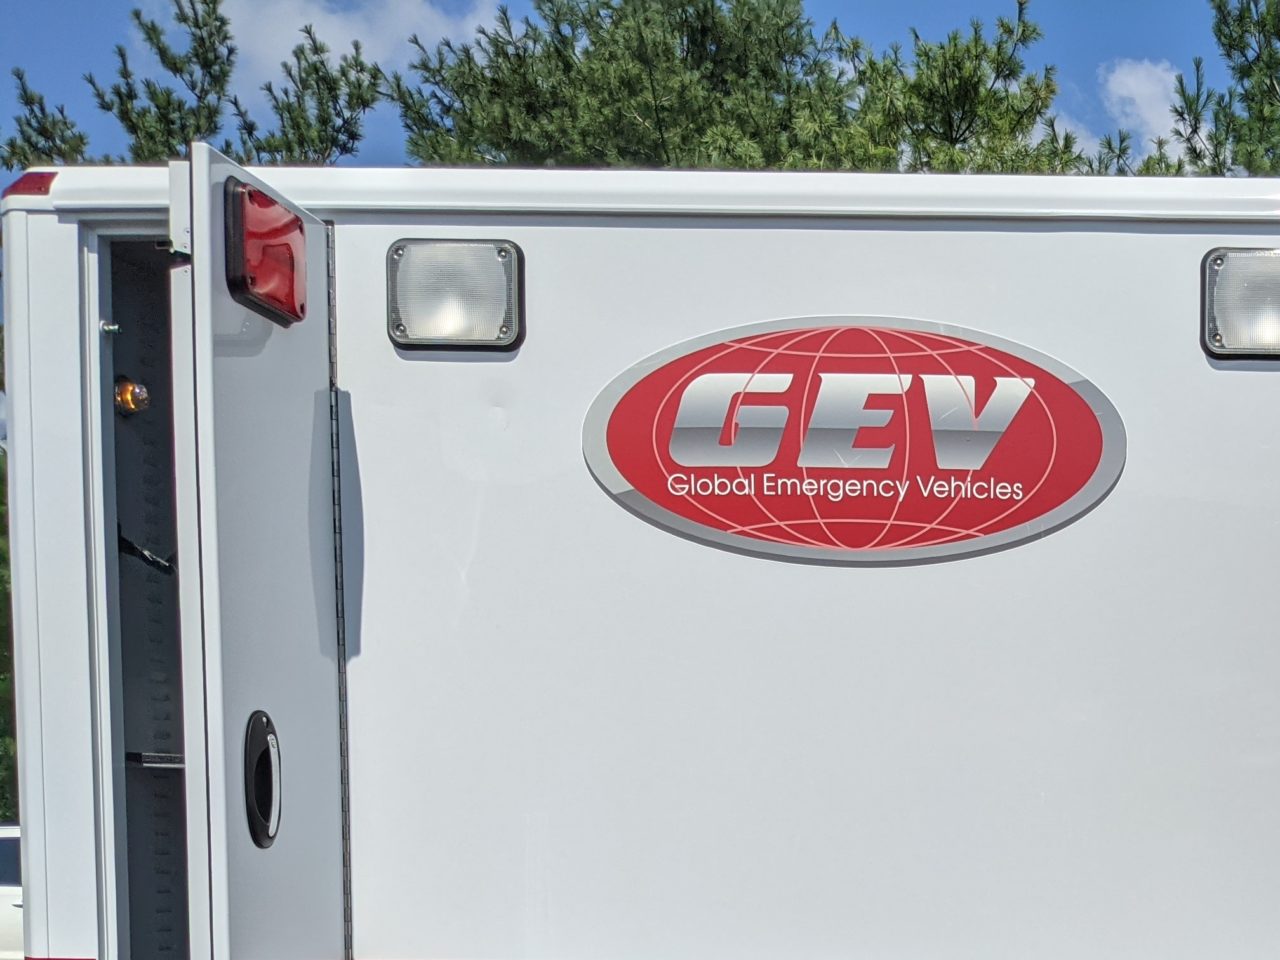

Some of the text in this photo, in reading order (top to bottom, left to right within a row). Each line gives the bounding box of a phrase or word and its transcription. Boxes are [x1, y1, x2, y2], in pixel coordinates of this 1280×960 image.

[669, 373, 1035, 469] GEV
[667, 473, 1023, 502] Global Emergency Vehicles
